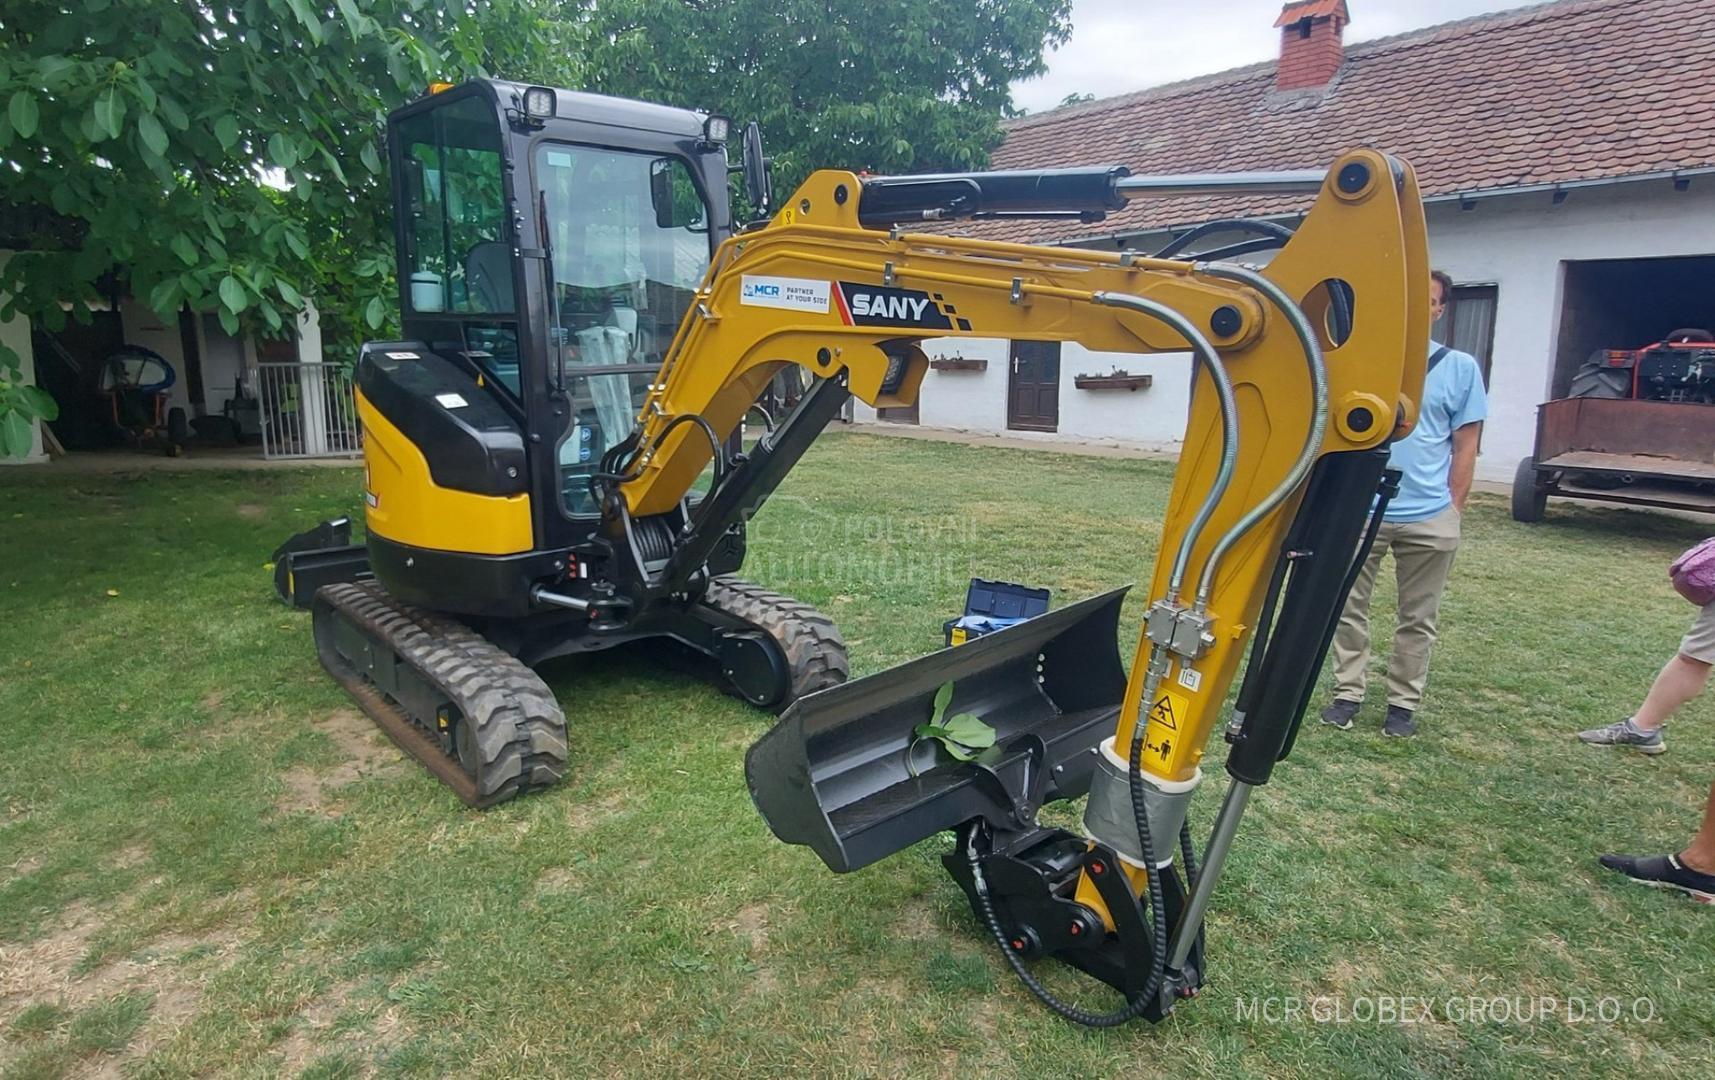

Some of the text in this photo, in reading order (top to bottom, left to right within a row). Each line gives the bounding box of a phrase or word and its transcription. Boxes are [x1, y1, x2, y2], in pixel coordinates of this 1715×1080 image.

[754, 284, 780, 296] MCR
[786, 287, 814, 295] PARTNER
[813, 296, 827, 305] SIDE
[852, 293, 930, 321] SANY
